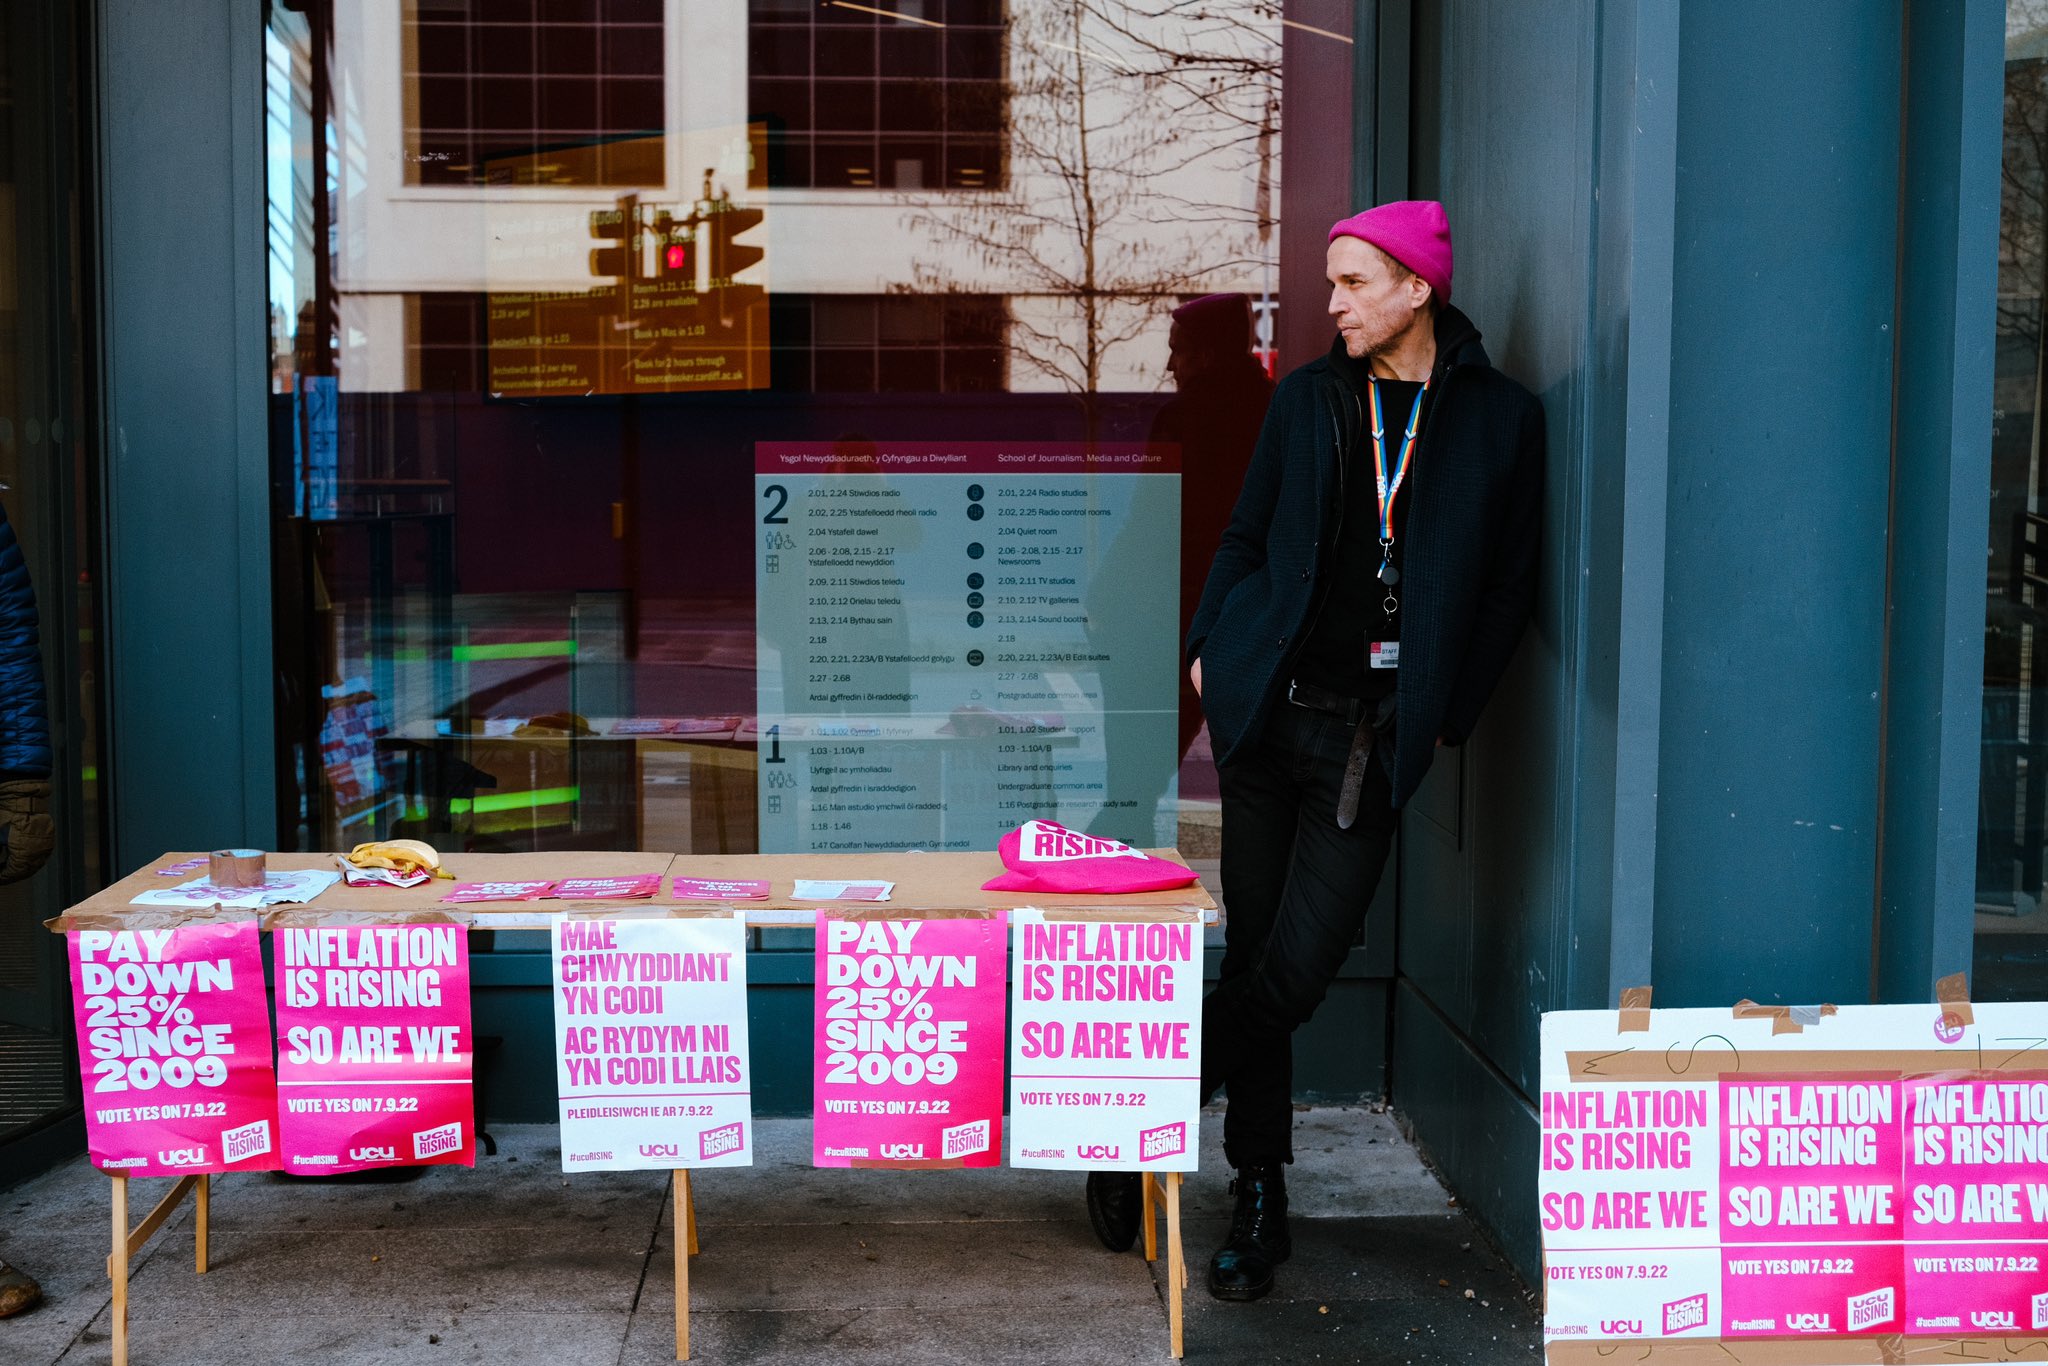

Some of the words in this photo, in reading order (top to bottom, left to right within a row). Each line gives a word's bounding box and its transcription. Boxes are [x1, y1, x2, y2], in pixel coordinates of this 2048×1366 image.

[780, 454, 801, 463] Ysgol
[803, 454, 874, 463] Newyddiaduraeth,
[882, 454, 920, 463] Cyfryngau
[929, 454, 967, 463] Diwylliant
[1038, 454, 1084, 463] Journalism,
[763, 485, 789, 524] 2
[856, 559, 894, 567] newyddion
[850, 617, 875, 626] Bythau
[810, 656, 829, 664] 2.20,
[831, 656, 850, 664] 2.21,
[766, 725, 786, 763] 1
[850, 767, 892, 775] ymholiadau
[998, 764, 1022, 772] Library
[1039, 764, 1072, 772] enquiries
[998, 783, 1051, 791] Undergraduate
[80, 930, 175, 962] PAY
[284, 928, 457, 967] INFLATION
[560, 921, 617, 950] MAE
[827, 921, 922, 954] PAY
[1023, 924, 1191, 961] INFLATION
[81, 959, 233, 995] DOWN
[562, 953, 732, 983] CHWYDDIANT
[827, 954, 976, 987] DOWN
[1023, 964, 1054, 1001] IS
[1062, 964, 1173, 1001] RISING
[285, 969, 318, 1008] IS
[326, 969, 441, 1008] RISING
[562, 986, 598, 1014] YN
[604, 986, 663, 1014] CODI
[826, 987, 933, 1020] 25%
[85, 995, 194, 1027] 25%
[89, 1024, 234, 1059] SINCE
[288, 1026, 332, 1064] SO
[339, 1026, 402, 1064] ARE
[407, 1026, 461, 1063] WE
[564, 1026, 597, 1054] AC
[603, 1025, 696, 1053] RYDYM
[703, 1025, 728, 1052] NI
[826, 1019, 967, 1052] SINCE
[1021, 1021, 1064, 1059] SO
[1071, 1023, 1132, 1059] ARE
[1139, 1023, 1189, 1059] WE
[93, 1055, 227, 1093] 2009
[565, 1058, 601, 1086] YN
[607, 1056, 666, 1085] CODI
[672, 1056, 741, 1084] LLAIS
[825, 1052, 958, 1085] 2009
[96, 1108, 131, 1124] VOTE
[134, 1106, 159, 1120] YES
[161, 1105, 181, 1119] ON
[183, 1102, 226, 1118] 7.9.22
[568, 1107, 648, 1119] PLEIDLEISIWCH
[651, 1107, 660, 1117] IE
[663, 1106, 676, 1117] AR
[678, 1106, 713, 1116] 7.9.22
[1021, 1092, 1052, 1106] VOTE
[1056, 1093, 1080, 1106] YES
[1083, 1093, 1101, 1106] ON
[1104, 1093, 1146, 1106] 7.9.22
[1543, 1090, 1706, 1129] INFLATION
[1729, 1084, 1892, 1126] INFLATION
[228, 1135, 264, 1158] RISING
[420, 1136, 456, 1155] RISING
[704, 1135, 739, 1155] RISING
[1144, 1135, 1180, 1158] RISING
[1543, 1132, 1574, 1171] IS
[1582, 1131, 1690, 1170] RISING
[1729, 1127, 1762, 1167] IS
[1768, 1125, 1876, 1166] RISING
[1543, 1192, 1584, 1231] SO
[1592, 1192, 1651, 1230] ARE
[1658, 1191, 1707, 1228] WE
[1728, 1186, 1772, 1228] SO
[1778, 1185, 1838, 1226] ARE
[1844, 1185, 1894, 1224] WE
